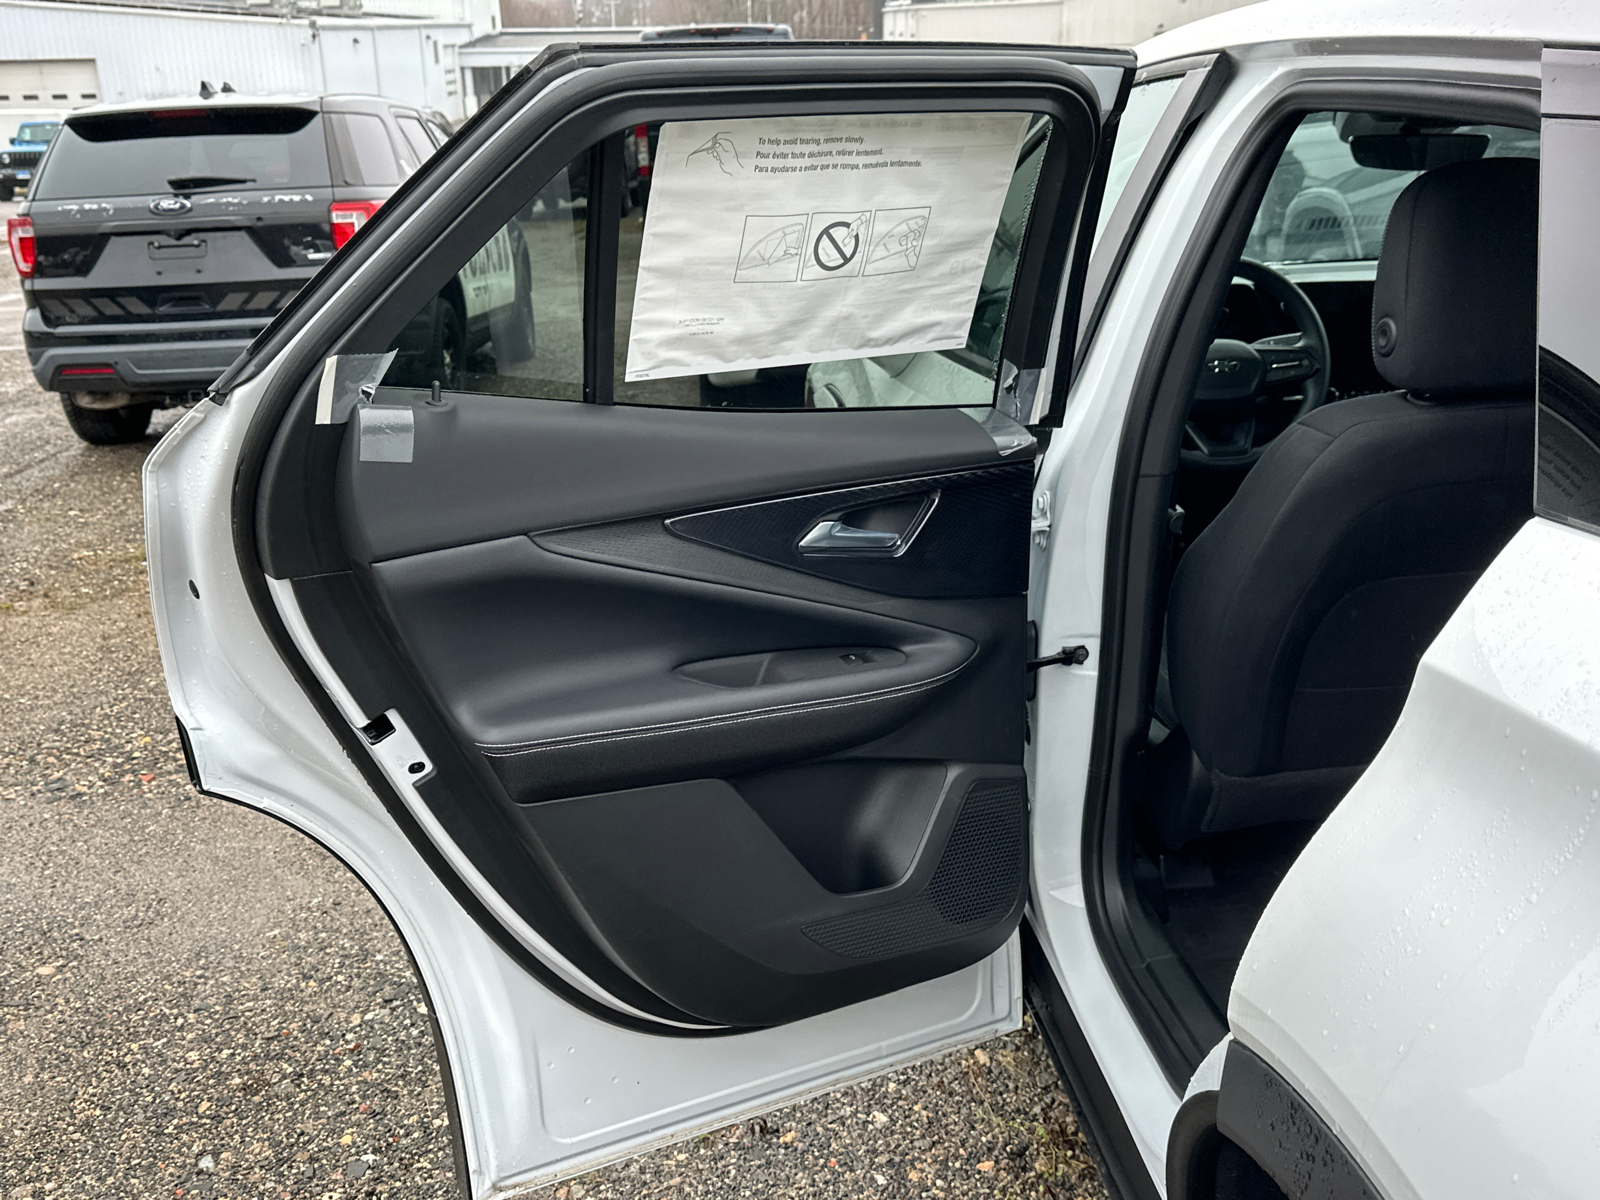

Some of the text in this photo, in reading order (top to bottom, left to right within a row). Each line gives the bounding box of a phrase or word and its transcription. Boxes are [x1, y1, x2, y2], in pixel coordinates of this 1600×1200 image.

[767, 138, 781, 147] help
[800, 137, 821, 146] tearing,
[756, 151, 771, 159] Pour
[772, 151, 789, 159] éviter
[791, 151, 806, 159] toute
[835, 149, 854, 157] retirer
[754, 165, 769, 173] Para
[770, 165, 797, 174] ayudarse
[840, 162, 860, 171] rompa,
